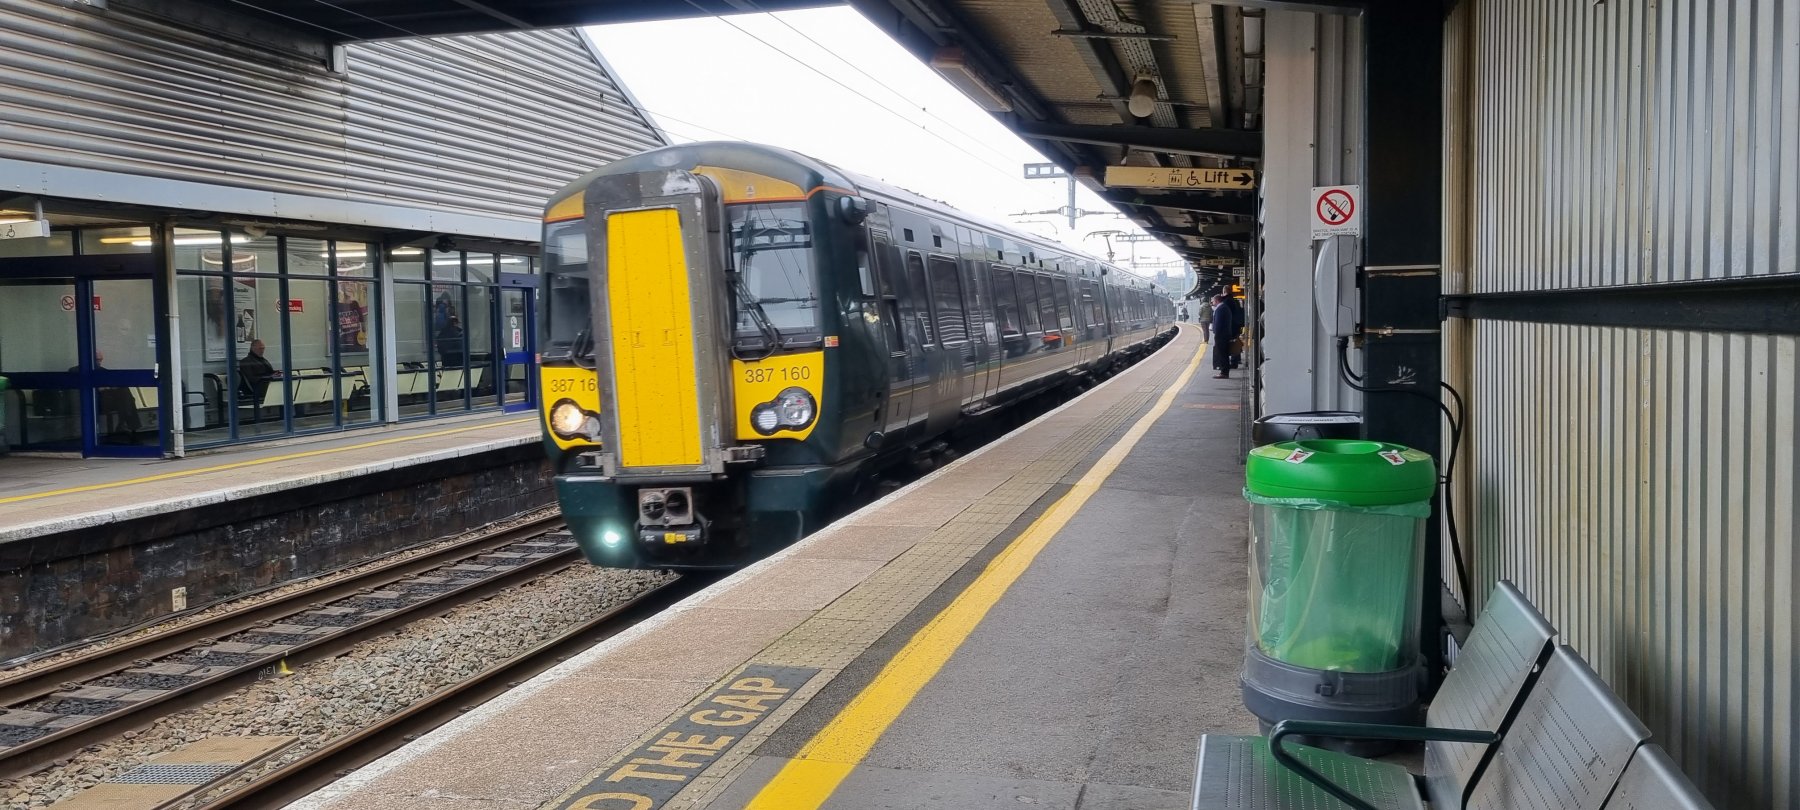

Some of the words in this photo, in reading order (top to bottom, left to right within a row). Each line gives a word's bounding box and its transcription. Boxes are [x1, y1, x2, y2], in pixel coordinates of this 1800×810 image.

[1204, 170, 1229, 184] Lift
[744, 367, 774, 383] 387
[780, 365, 810, 381] 160
[551, 378, 575, 392] 387
[579, 377, 598, 391] 16
[605, 730, 735, 783] THE
[689, 677, 791, 727] GAP
